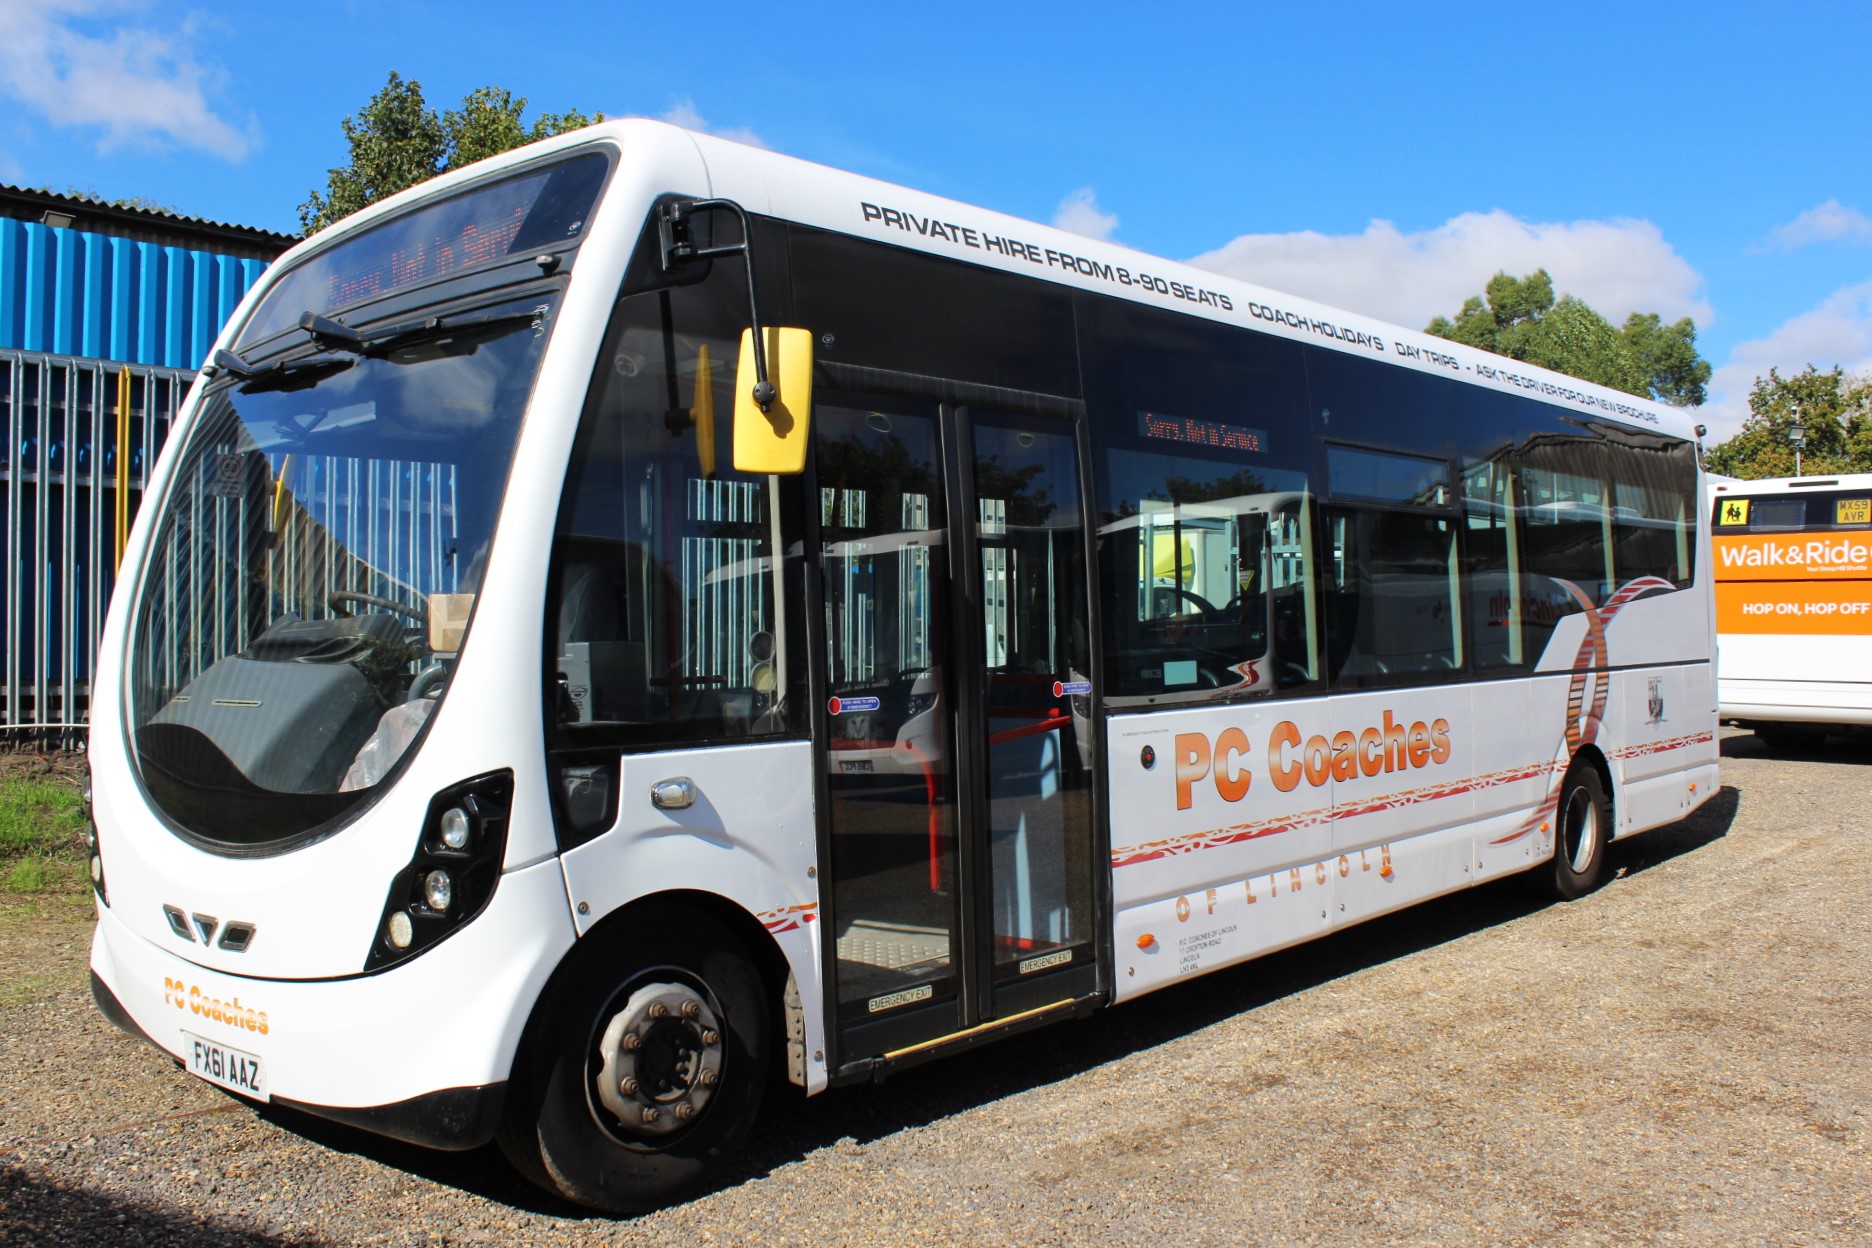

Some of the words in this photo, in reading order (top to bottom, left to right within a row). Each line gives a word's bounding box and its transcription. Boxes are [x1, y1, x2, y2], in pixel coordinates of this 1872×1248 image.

[861, 202, 980, 249] PRIVATE
[983, 232, 1043, 264] HIRE
[1045, 249, 1115, 282] FROM
[1116, 267, 1168, 296] 8-90
[1170, 282, 1233, 311] SEATS
[1248, 302, 1309, 331] COACH
[1310, 318, 1384, 351] HOLIDAYS
[1395, 342, 1420, 360] DAY
[1422, 349, 1459, 370] TRIPS
[1476, 364, 1499, 381] ASK
[1499, 370, 1521, 387] THE
[1521, 377, 1558, 396] DRIVER
[1558, 386, 1576, 401] FOR
[1576, 392, 1596, 406] OUR
[1596, 398, 1616, 412] NEW
[1616, 403, 1659, 424] BROCHURE
[1844, 511, 1865, 521] AVR
[1720, 540, 1868, 567] Walk&Ride
[1743, 603, 1774, 615] HOP
[1776, 603, 1802, 616] ON,
[1804, 603, 1837, 615] HOP
[1839, 602, 1870, 614] OFF
[1174, 727, 1252, 811] PC
[1268, 710, 1451, 793] Coaches
[1176, 888, 1217, 922] OF
[1245, 844, 1392, 905] LINCOLN
[1021, 955, 1058, 972] EMERGENCY
[1058, 951, 1071, 963] EXIT
[164, 976, 184, 1009] PC
[189, 985, 269, 1035] Coaches
[870, 991, 916, 1011] EMERGENCY
[916, 987, 932, 999] EXIT
[194, 1041, 225, 1080] FX61
[230, 1054, 260, 1092] AAZ
